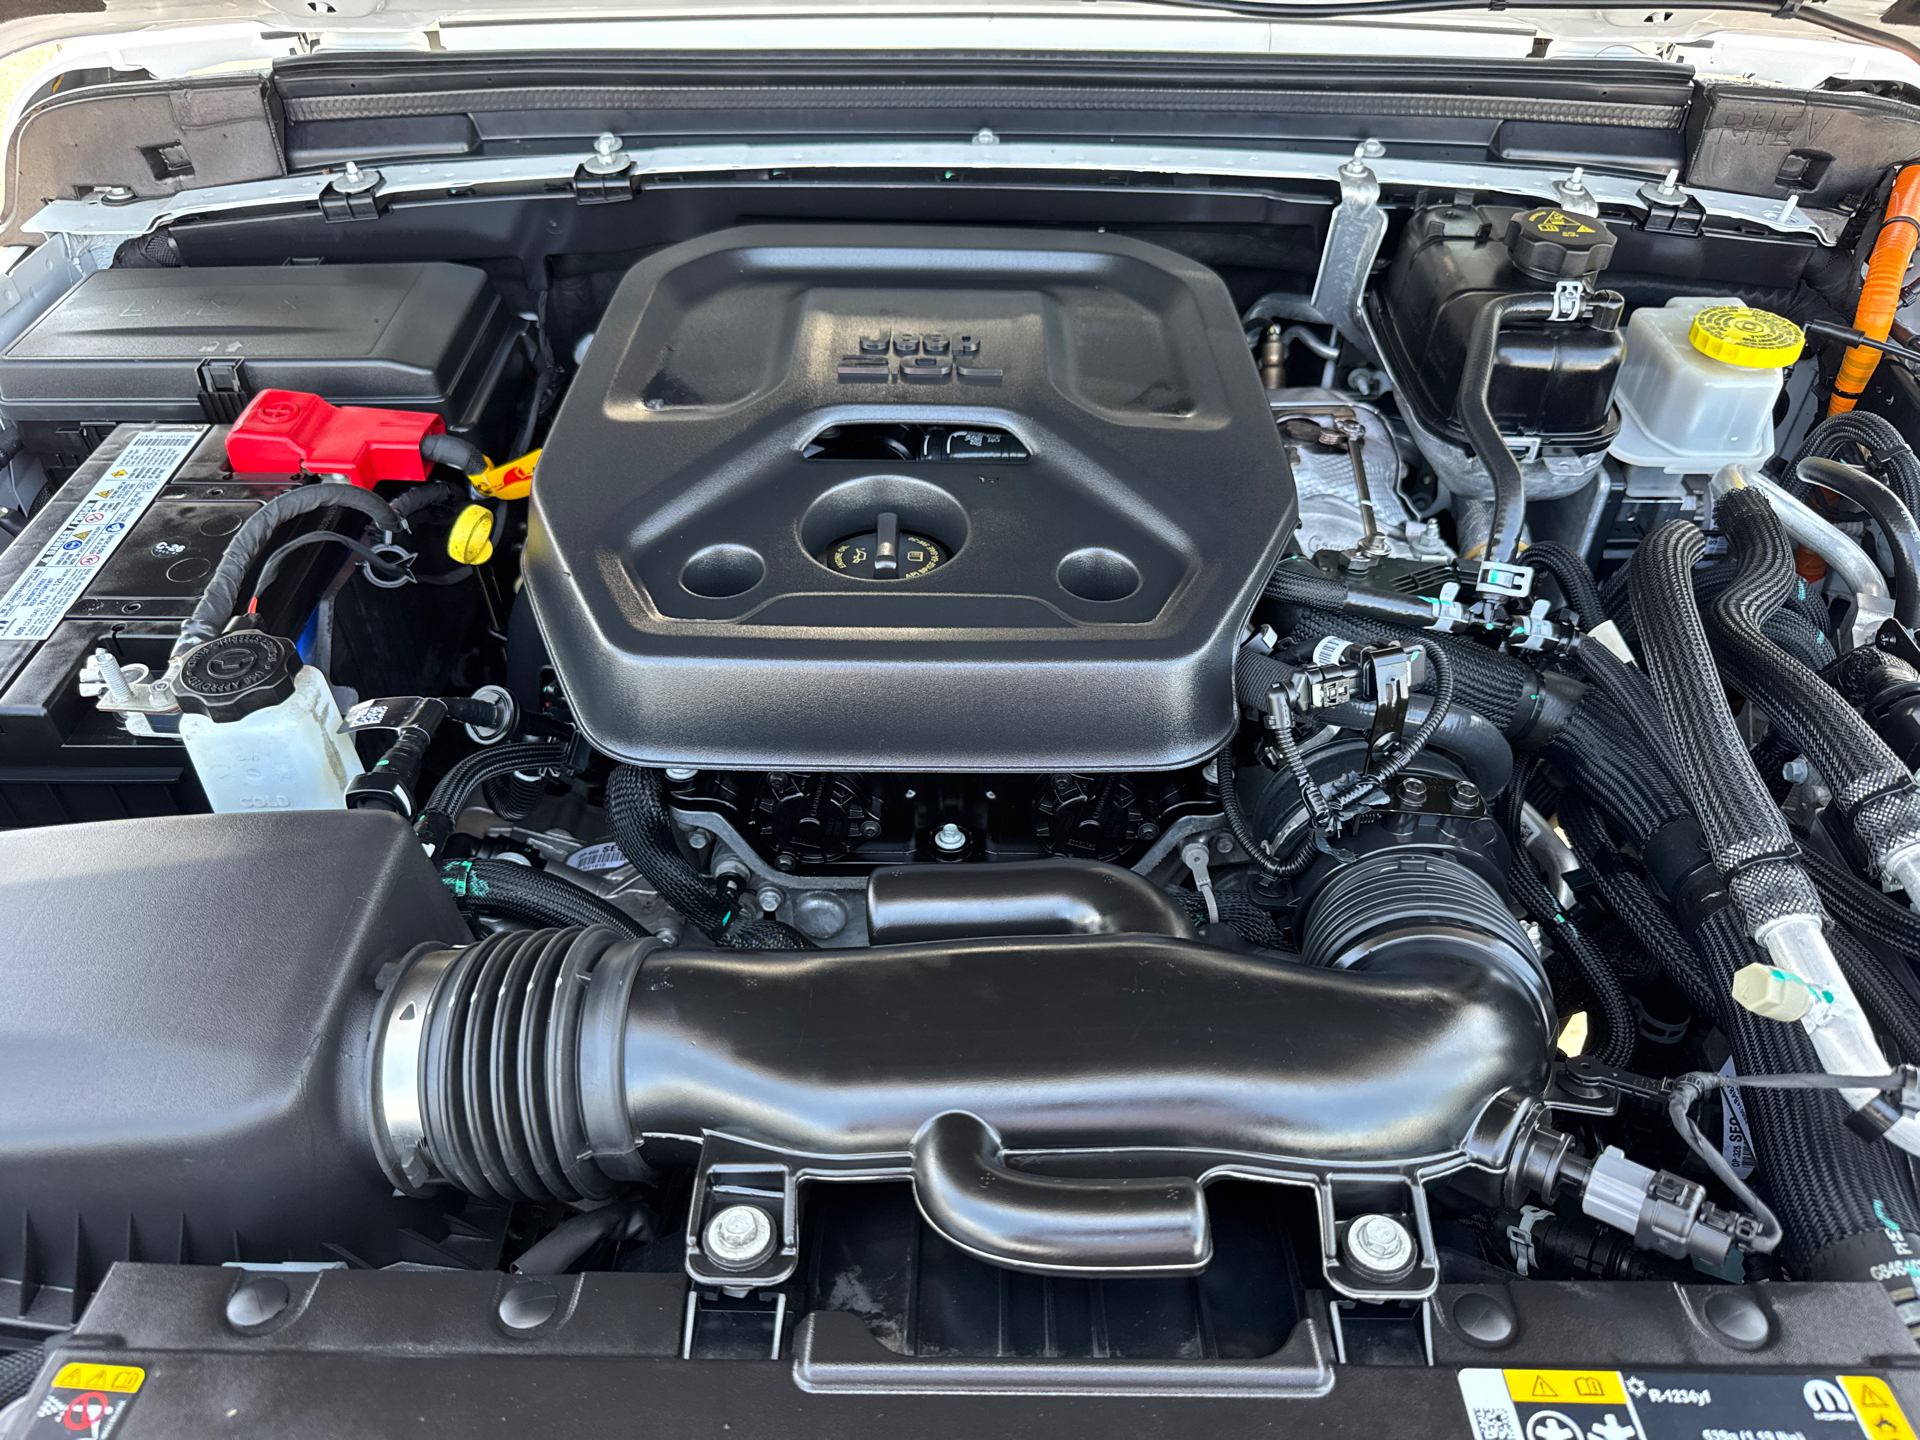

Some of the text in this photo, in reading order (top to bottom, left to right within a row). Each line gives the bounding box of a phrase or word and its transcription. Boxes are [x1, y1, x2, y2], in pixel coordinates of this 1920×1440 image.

[1715, 110, 1834, 147] PHEV
[859, 326, 981, 356] Jeep
[838, 354, 1003, 383] 2.0L
[210, 634, 262, 649] STEERING
[187, 677, 240, 693] APPROVED
[240, 795, 290, 808] COLD
[1648, 1387, 1712, 1407] R-1234yf
[1740, 1429, 1775, 1440] (119
